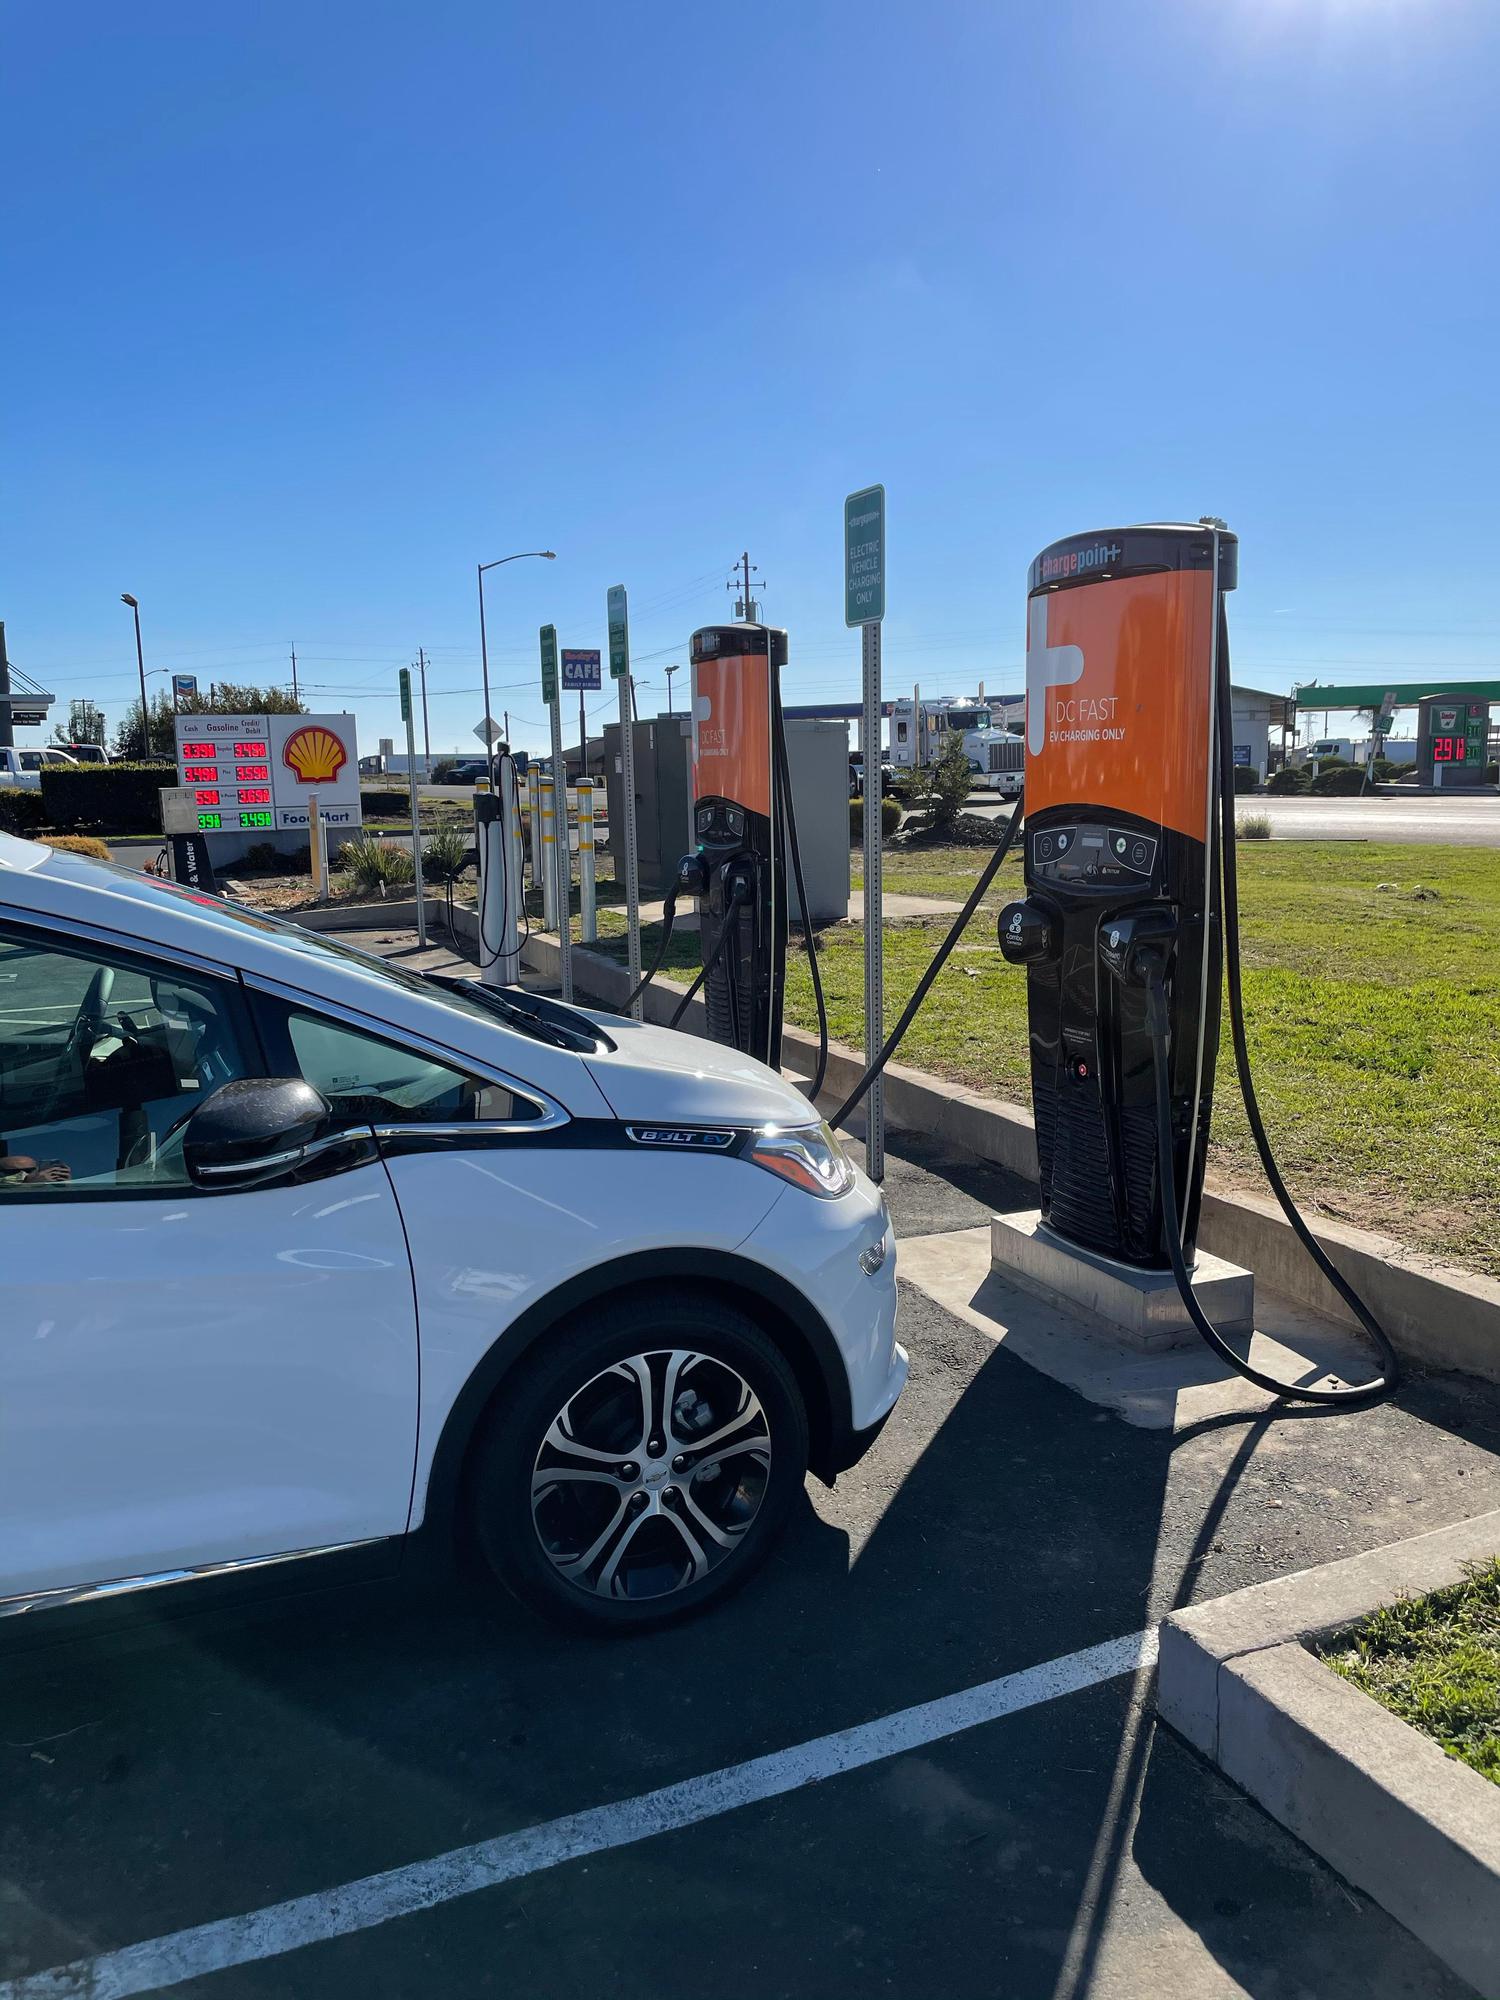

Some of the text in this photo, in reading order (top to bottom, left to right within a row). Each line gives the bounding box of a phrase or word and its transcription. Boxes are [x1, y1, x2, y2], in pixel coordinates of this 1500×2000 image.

[850, 539, 879, 559] ELECTRIC
[851, 556, 878, 574] VEHICLE
[849, 572, 881, 591] CHARGING
[856, 591, 873, 605] ONLY
[565, 663, 600, 679] CAFE
[1056, 697, 1119, 723] DC FAST
[206, 723, 239, 732] Gasoline
[1049, 727, 1126, 742] EV CHARGING ONLY
[283, 813, 309, 823] Foo
[186, 841, 197, 873] Water
[189, 874, 199, 883] &
[1006, 932, 1024, 942] Combo
[641, 1131, 727, 1144] BOLT EV
